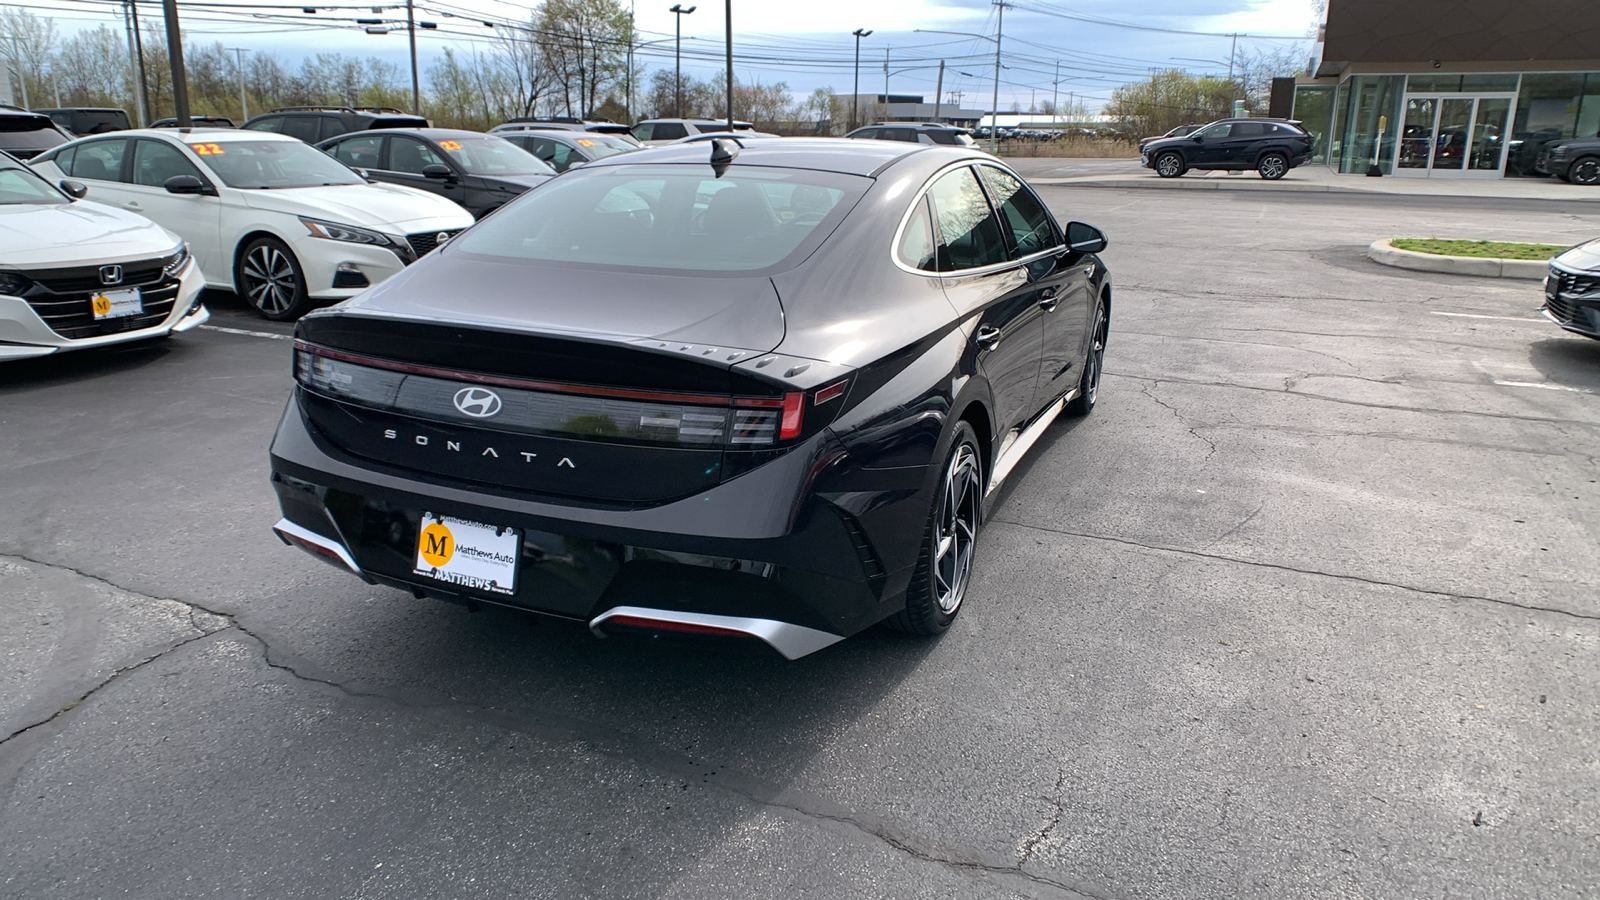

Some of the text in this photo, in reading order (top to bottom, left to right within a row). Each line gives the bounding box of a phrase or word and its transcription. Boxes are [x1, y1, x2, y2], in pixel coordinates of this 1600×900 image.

[192, 143, 226, 155] 22
[384, 429, 575, 468] SONATA
[424, 532, 448, 557] M
[455, 543, 514, 564] Matthews Auto
[434, 570, 492, 592] MATTHEWS
